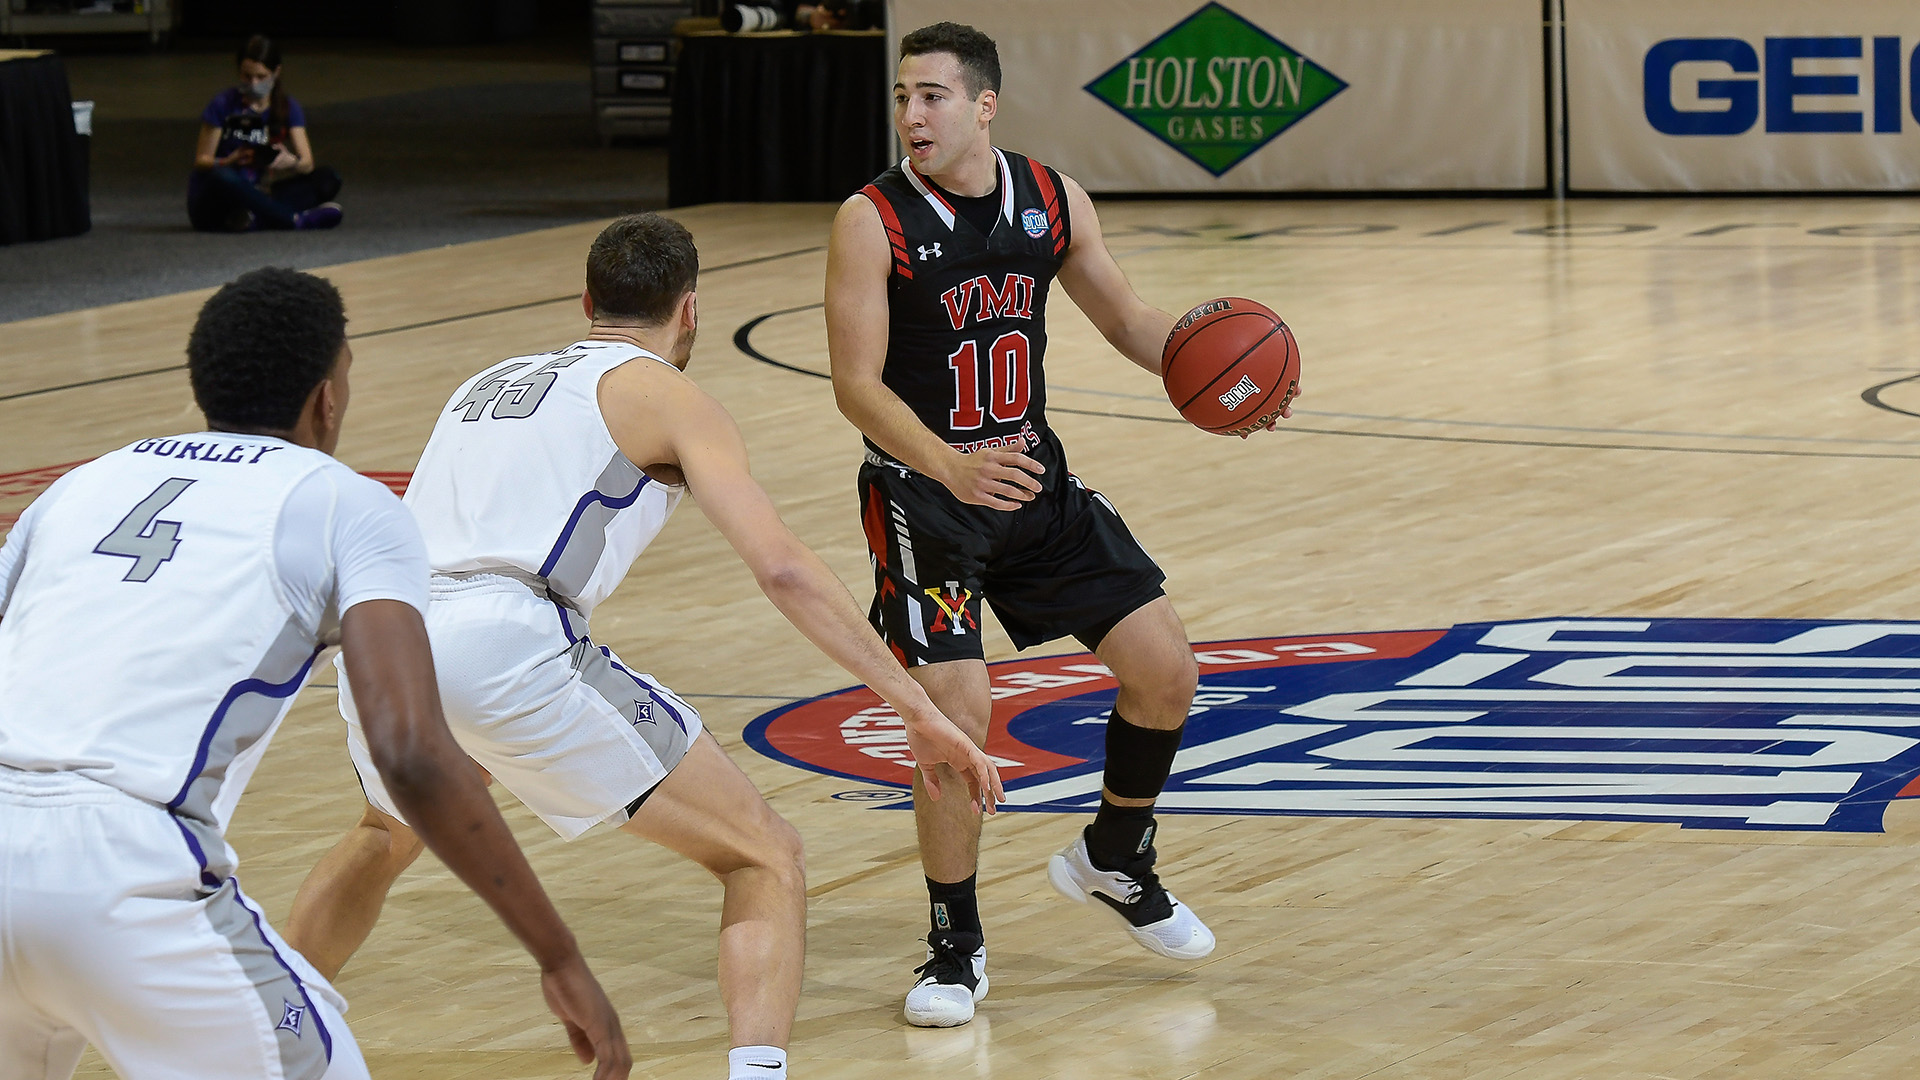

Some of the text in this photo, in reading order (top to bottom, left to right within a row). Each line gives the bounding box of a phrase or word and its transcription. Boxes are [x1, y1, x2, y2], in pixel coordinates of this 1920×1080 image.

[1124, 56, 1304, 109] HOLSTON
[1643, 36, 1920, 135] GEI
[1168, 116, 1263, 140] GASES
[940, 273, 1035, 330] VMI
[451, 353, 588, 422] 45
[948, 330, 1031, 430] 10
[1219, 375, 1259, 410] SOCON
[93, 477, 198, 583] 4
